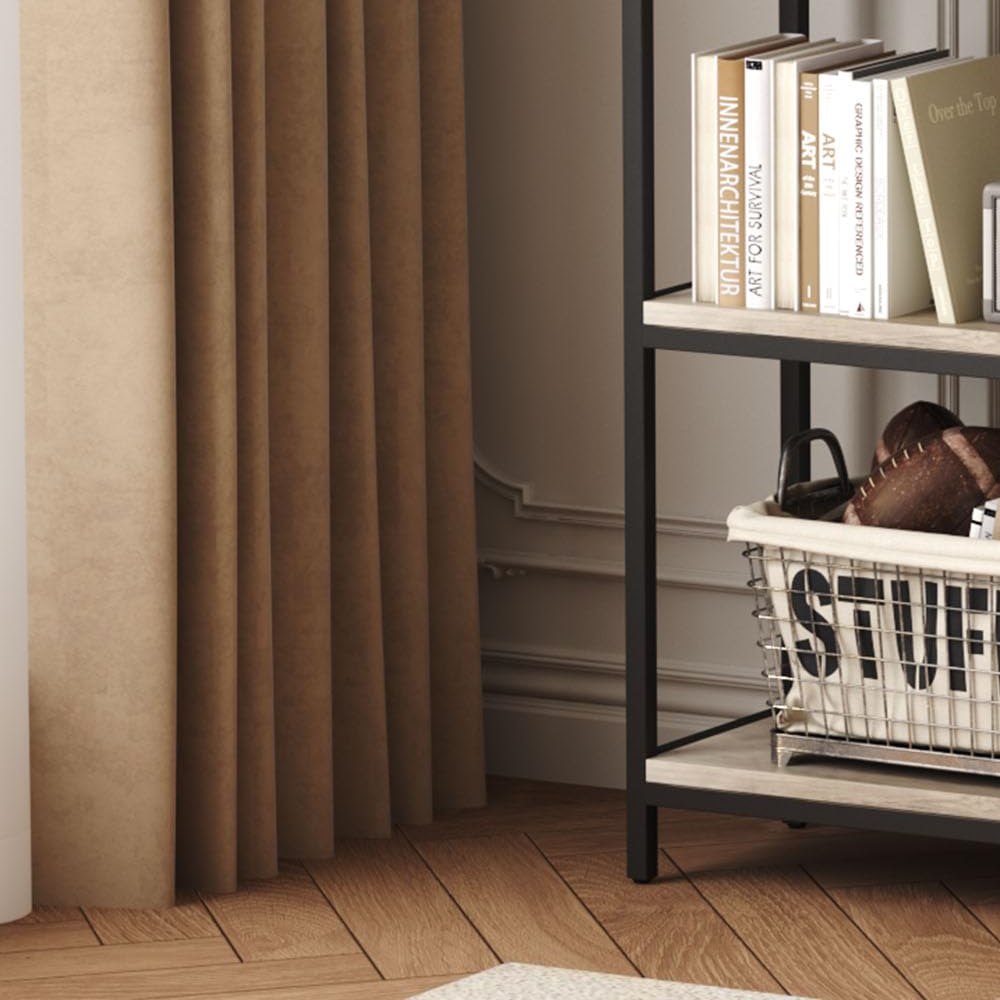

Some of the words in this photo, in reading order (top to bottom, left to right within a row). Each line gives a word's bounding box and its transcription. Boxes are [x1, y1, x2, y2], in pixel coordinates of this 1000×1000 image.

[854, 102, 864, 154] GRAPHIC
[927, 103, 954, 125] Over
[955, 95, 974, 117] the
[973, 91, 998, 117] Top
[800, 130, 818, 170] ART
[821, 132, 837, 171] ART
[718, 95, 741, 298] INNENARCHITEKTUR
[748, 163, 763, 229] SURVIVAL
[854, 156, 864, 200] DESIGN
[748, 235, 763, 264] FOR
[854, 201, 864, 277] REFERENCED
[748, 268, 763, 297] ART
